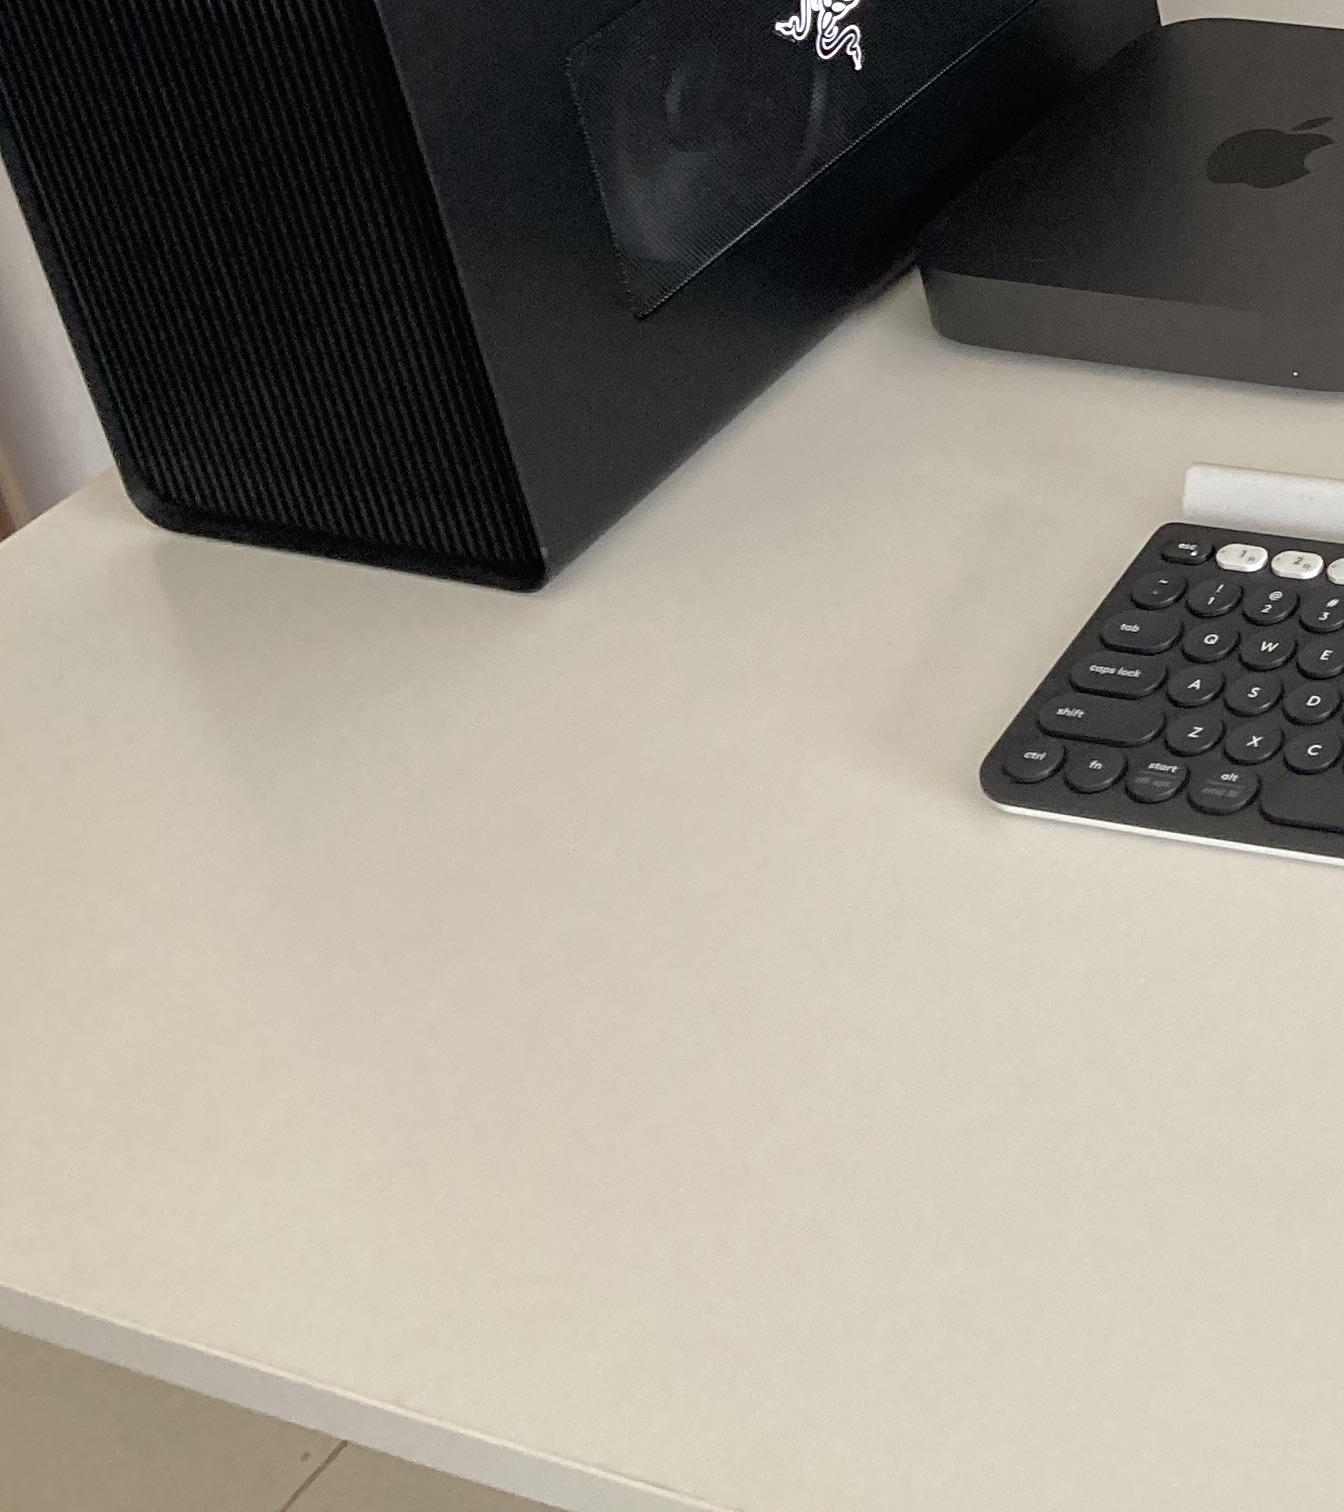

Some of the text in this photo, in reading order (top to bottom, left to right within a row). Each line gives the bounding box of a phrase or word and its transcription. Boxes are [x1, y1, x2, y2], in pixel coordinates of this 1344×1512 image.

[1204, 634, 1218, 644] Q
[1261, 642, 1279, 652] W
[1320, 650, 1332, 660] E
[1188, 679, 1200, 689] A
[1248, 687, 1260, 697] S
[1306, 696, 1321, 706] D
[1188, 727, 1203, 737] Z
[1247, 736, 1262, 747] X
